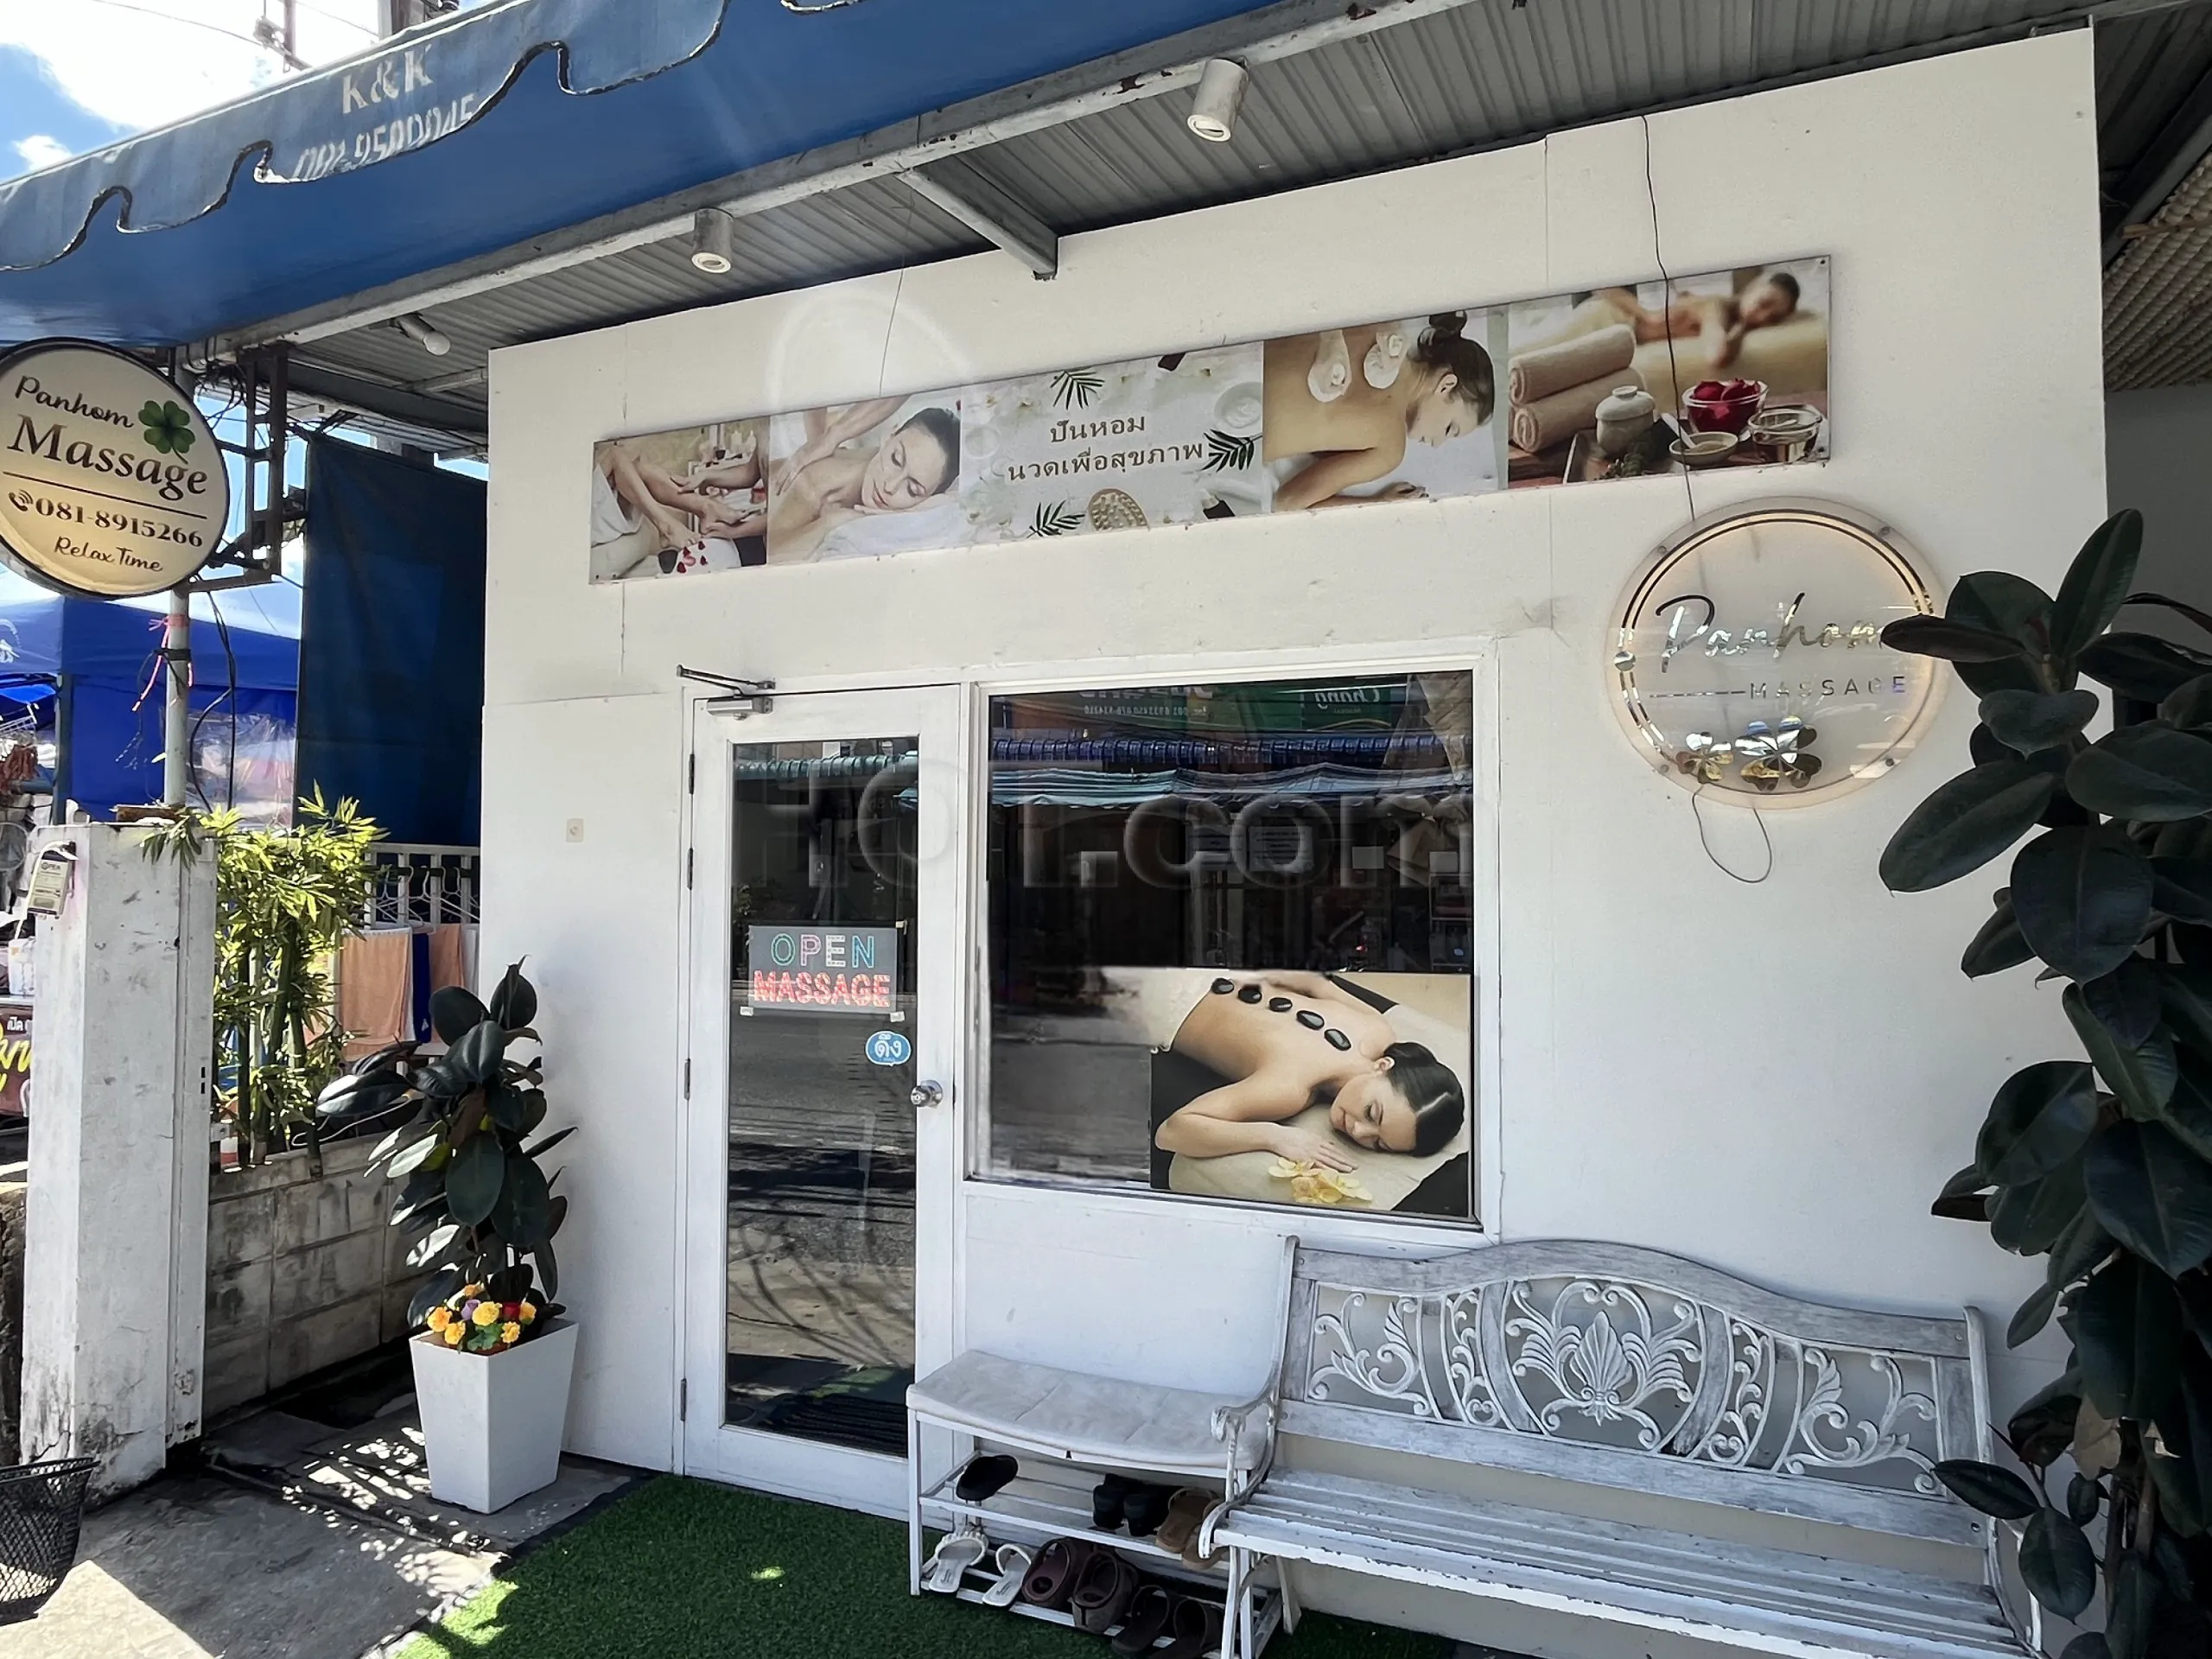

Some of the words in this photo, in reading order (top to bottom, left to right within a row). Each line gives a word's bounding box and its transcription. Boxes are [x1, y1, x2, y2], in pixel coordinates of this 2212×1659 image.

[343, 43, 433, 114] K&K
[15, 375, 133, 429] Panhom
[7, 414, 207, 500] Massage
[35, 498, 203, 547] 081-8915266
[54, 536, 115, 563] Relax
[116, 546, 162, 572] Time
[1750, 676, 1905, 699] MASSAGE
[771, 933, 874, 969] OPEN
[753, 970, 891, 1007] MASSAGE
